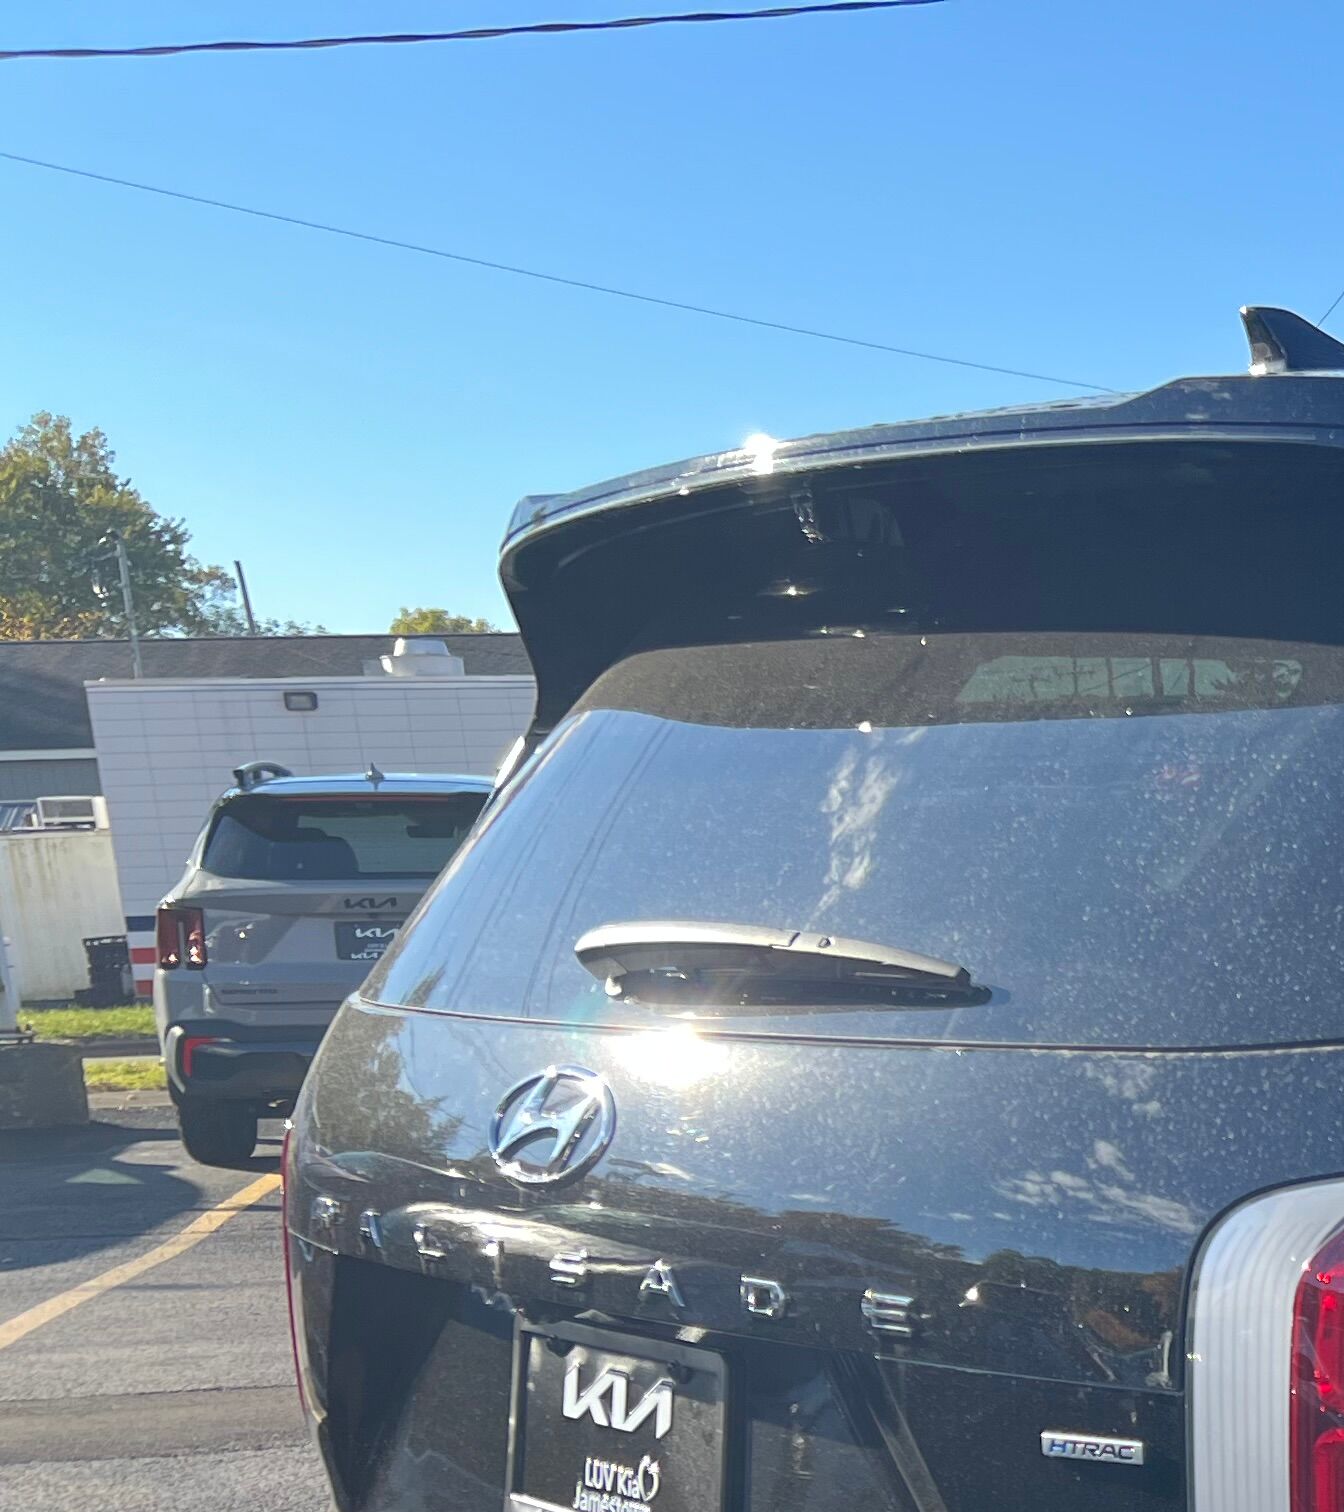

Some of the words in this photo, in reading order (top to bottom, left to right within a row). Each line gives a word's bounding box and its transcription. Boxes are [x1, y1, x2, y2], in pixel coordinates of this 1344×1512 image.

[562, 1363, 674, 1440] KIA
[1049, 1439, 1136, 1461] HTRAC
[584, 1456, 617, 1493] LUV
[617, 1464, 641, 1500] Kia
